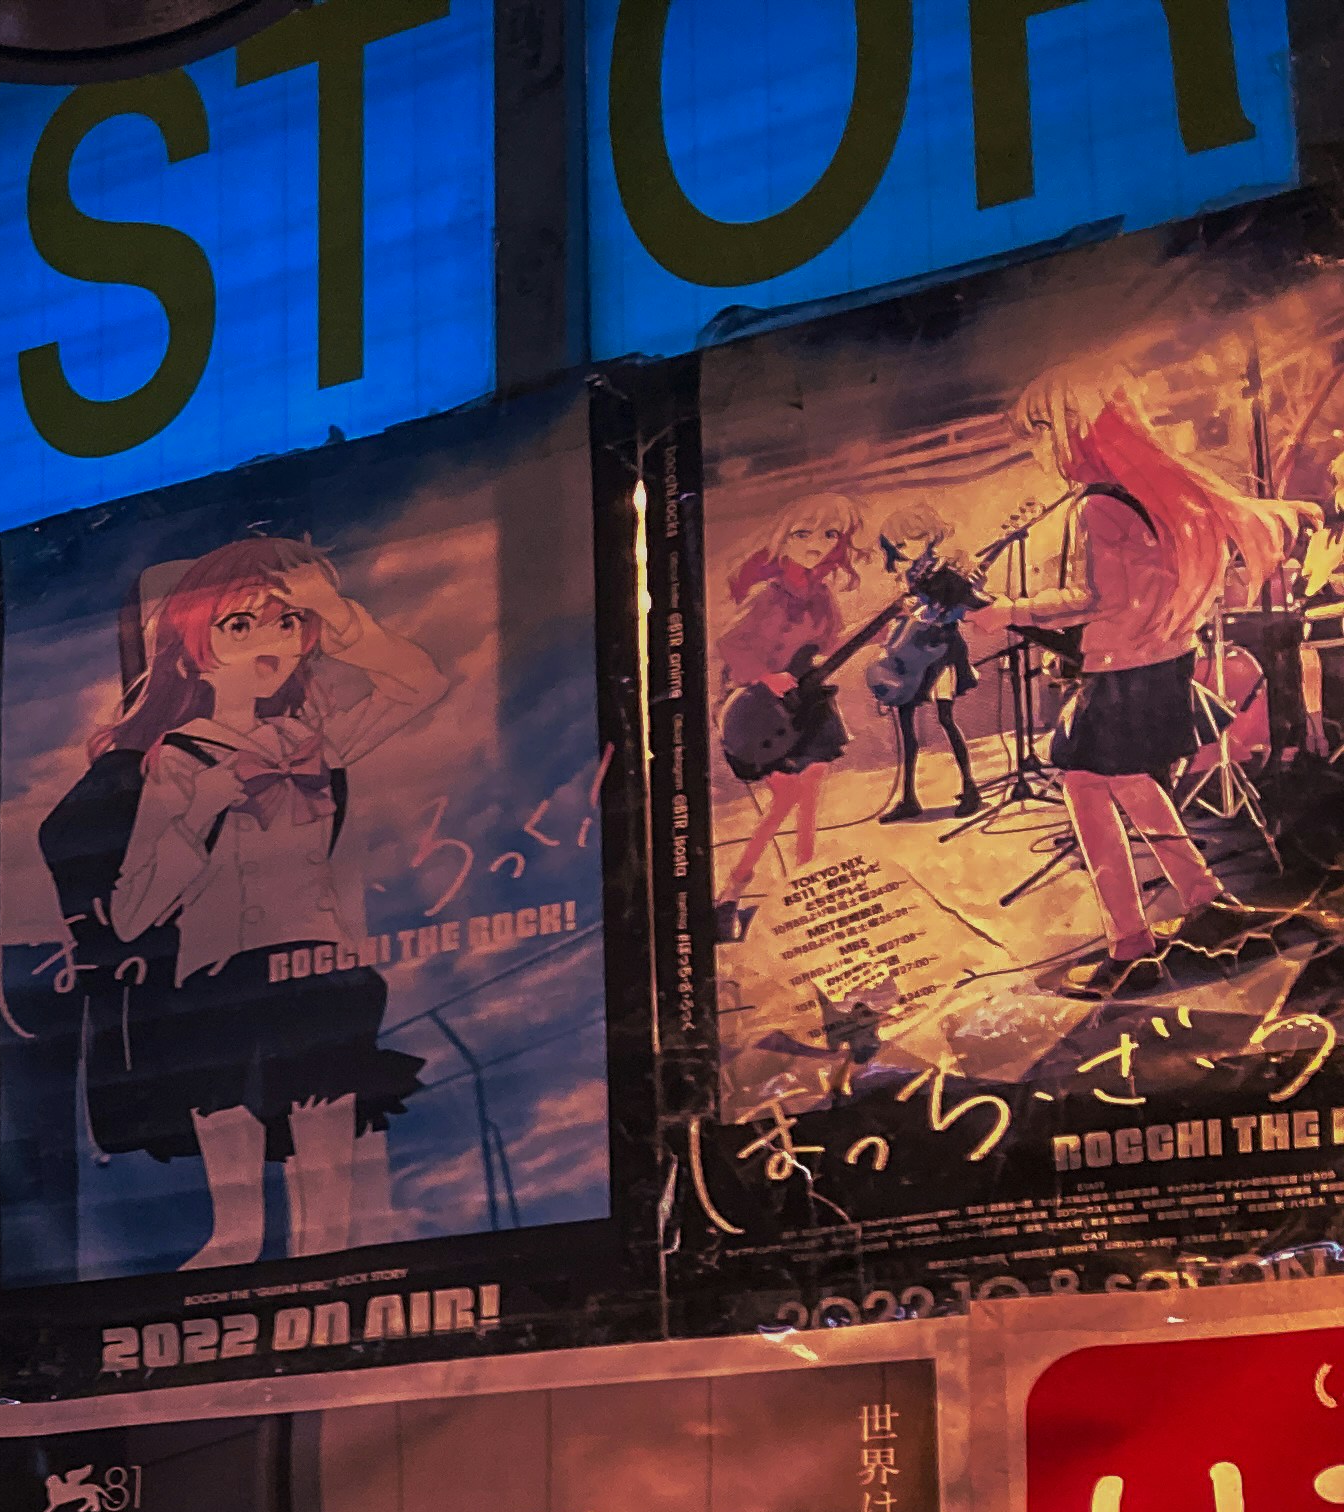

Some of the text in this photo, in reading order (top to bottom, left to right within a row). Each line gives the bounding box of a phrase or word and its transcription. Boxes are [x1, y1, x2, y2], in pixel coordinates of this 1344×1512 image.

[267, 901, 577, 983] BOCCHI THE ROCK!
[1053, 1106, 1322, 1173] BOCCHI THE
[101, 1283, 502, 1372] 2022 ON AIR!
